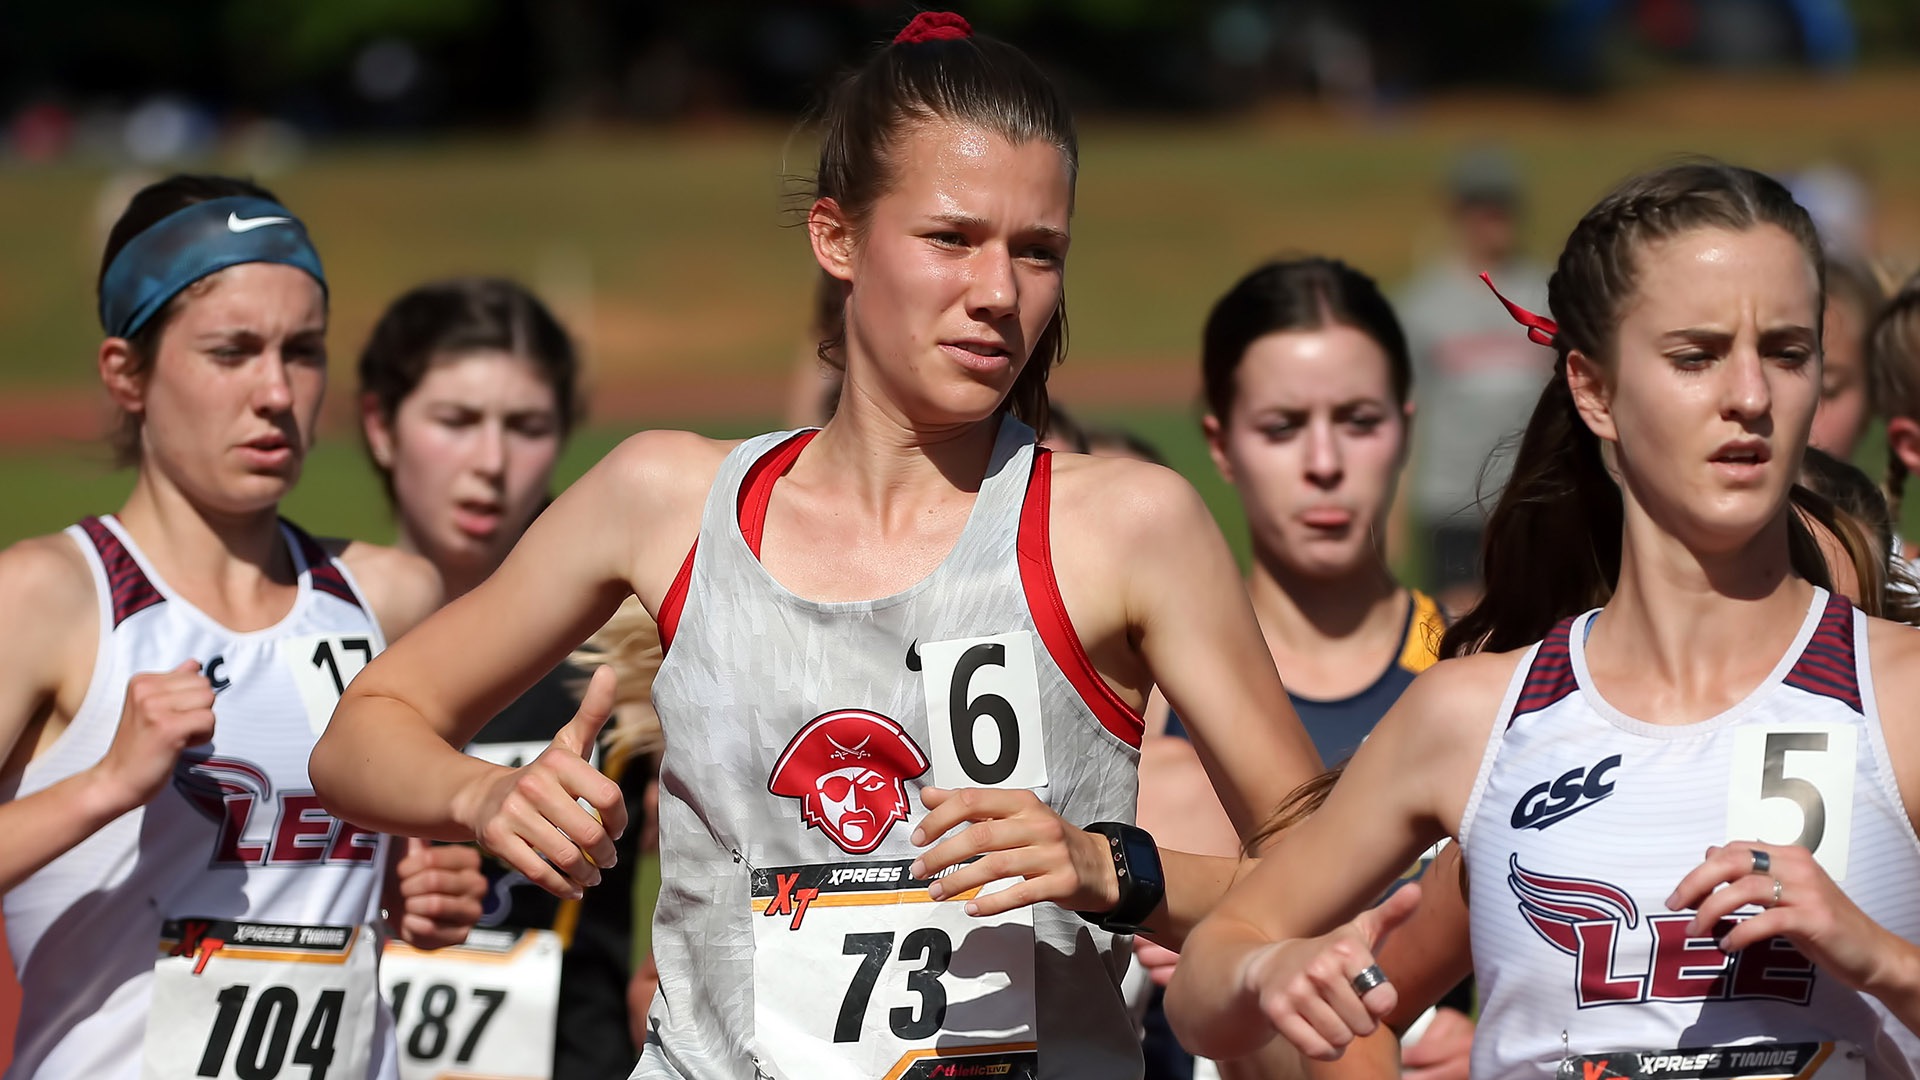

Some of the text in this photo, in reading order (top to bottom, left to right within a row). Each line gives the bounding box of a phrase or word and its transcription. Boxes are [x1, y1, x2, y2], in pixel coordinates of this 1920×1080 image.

[950, 643, 1020, 785] 6
[1510, 754, 1623, 830] GSC
[1760, 732, 1828, 857] 5
[764, 872, 819, 931] XT
[828, 866, 902, 886] XPRESS
[234, 924, 297, 943] XPRESS
[389, 981, 508, 1065] 187
[833, 927, 952, 1043] 73
[197, 984, 345, 1080] 104
[1640, 1053, 1720, 1075] XPRESS
[1730, 1050, 1797, 1068] TIMING
